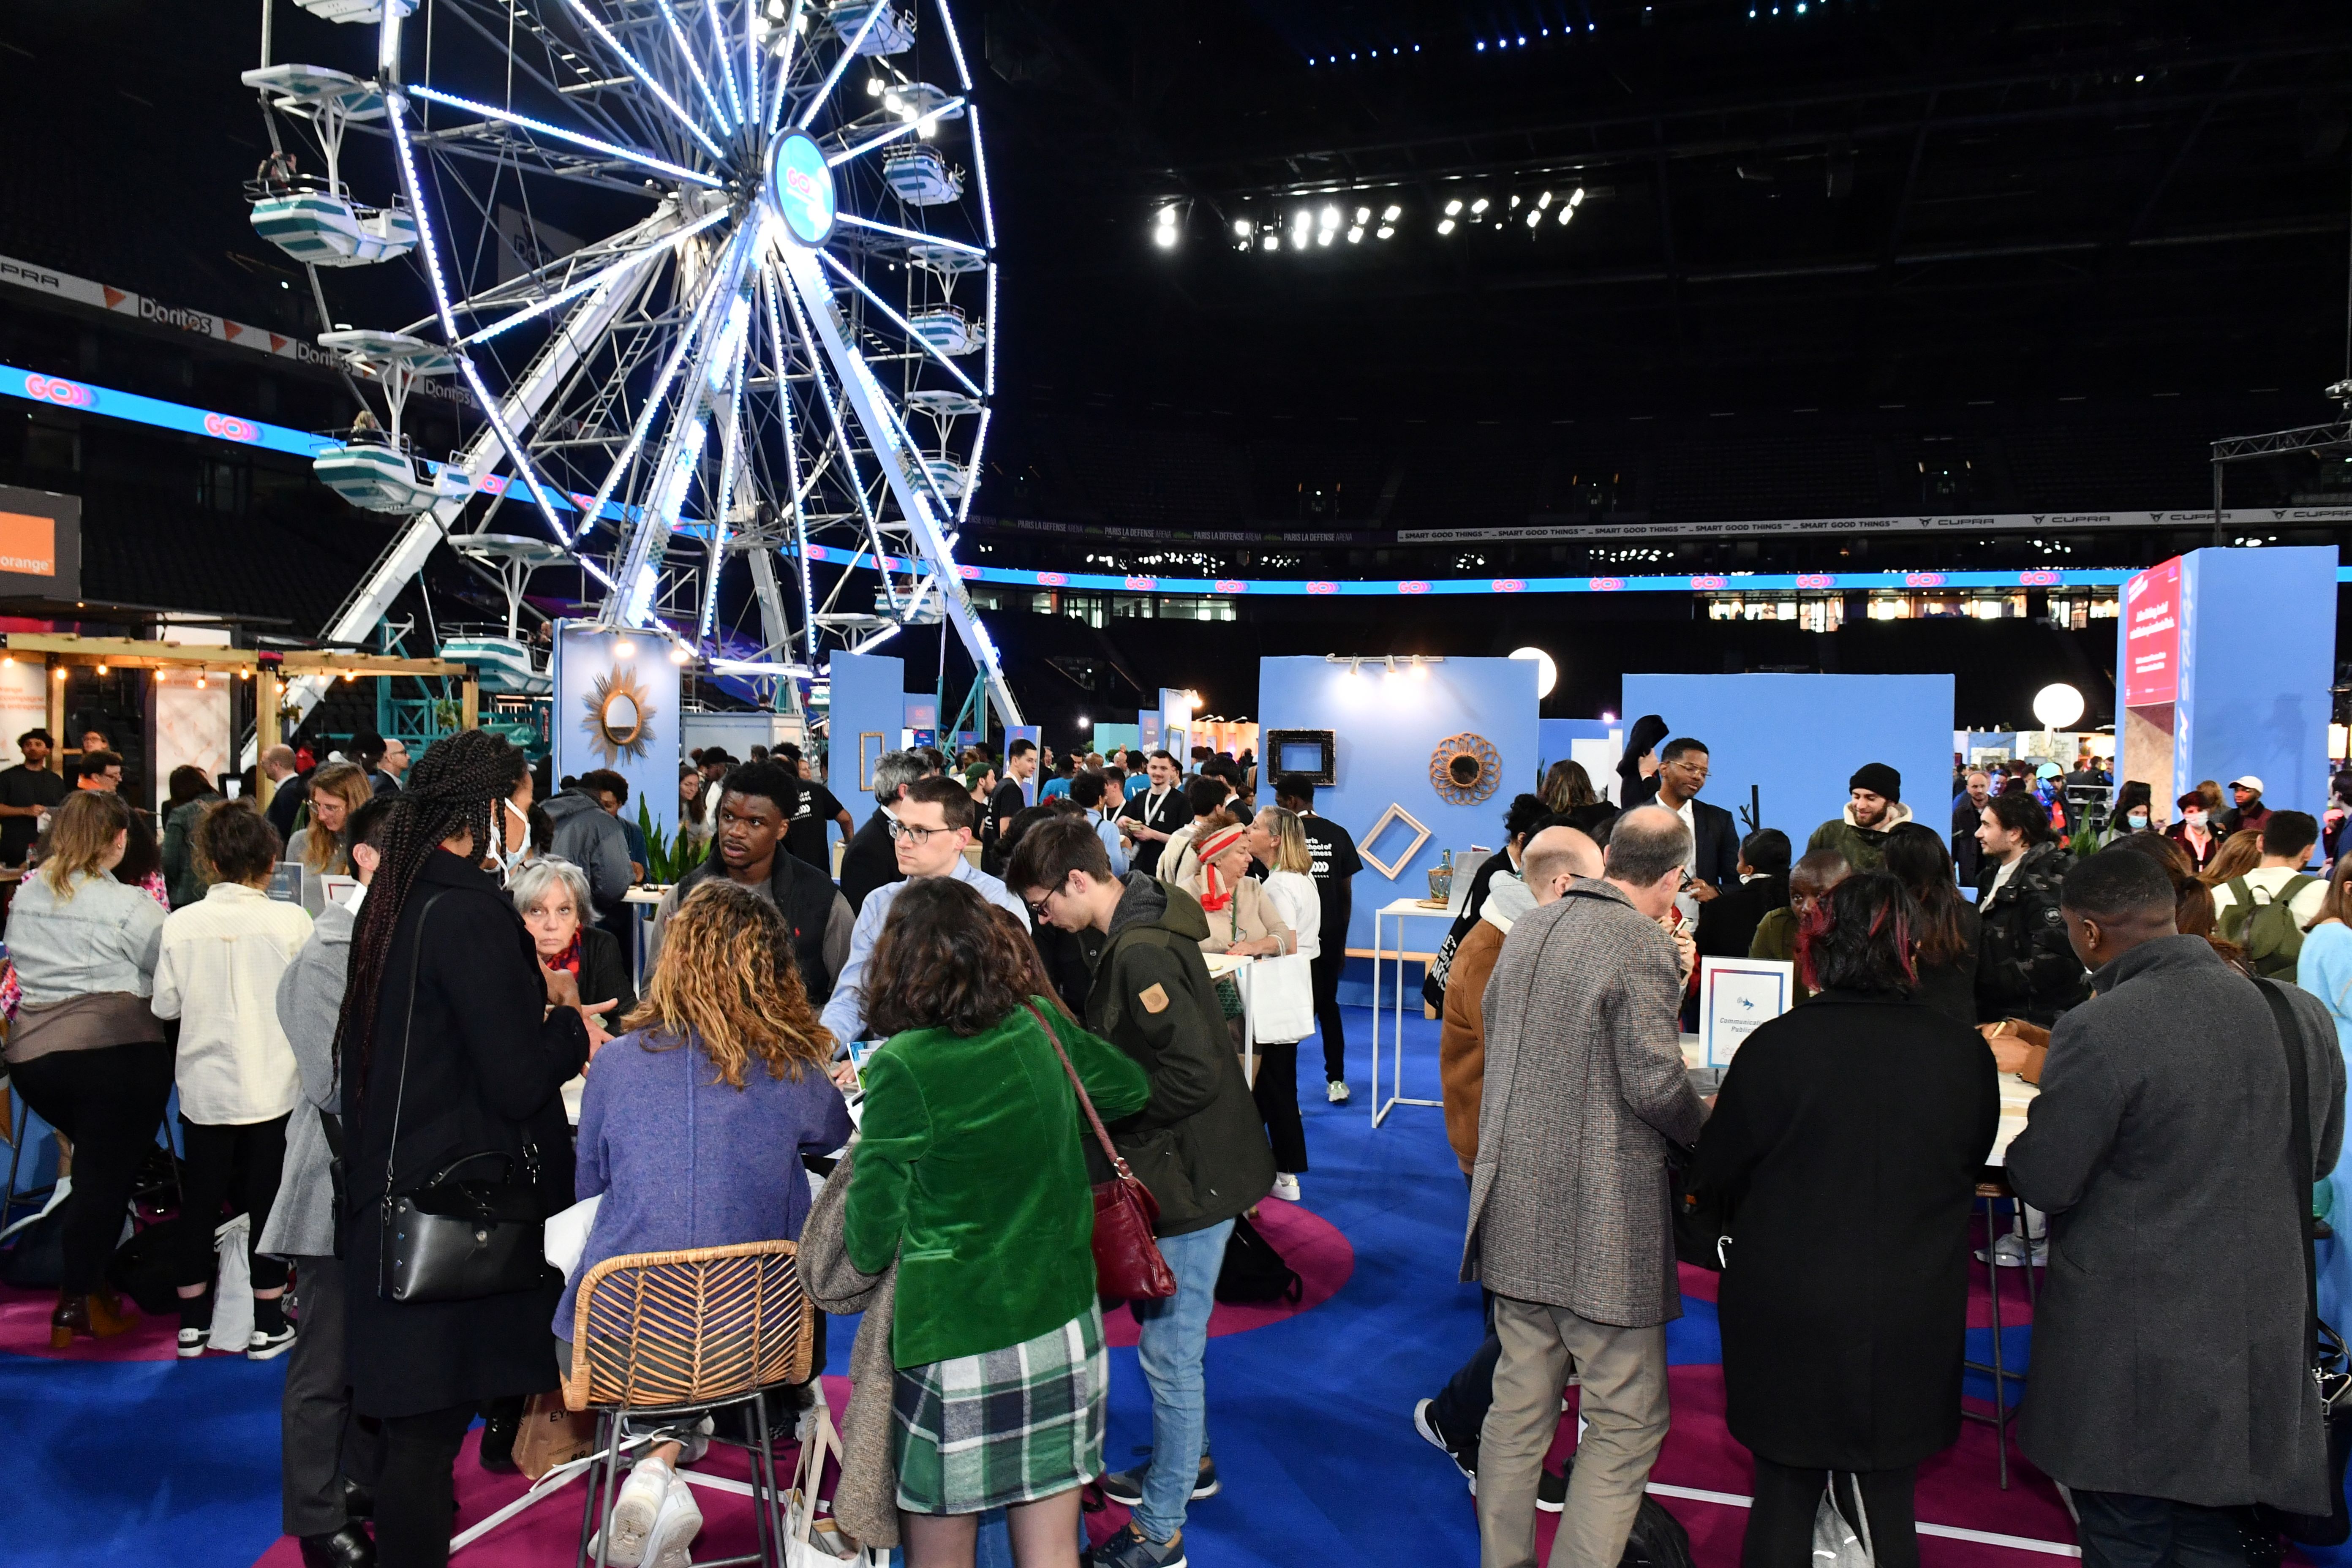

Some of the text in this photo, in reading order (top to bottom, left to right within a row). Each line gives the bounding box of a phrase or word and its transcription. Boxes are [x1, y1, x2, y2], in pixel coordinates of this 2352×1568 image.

[787, 168, 810, 194] GO
[140, 297, 211, 334] Doritos
[297, 342, 353, 373] Doris
[25, 374, 74, 405] GO
[204, 413, 245, 440] GO
[1018, 520, 1034, 529] PARIS
[1035, 521, 1042, 530] LA
[1042, 522, 1066, 532] DEFENSE
[1105, 527, 1121, 536] PARIS
[1122, 528, 1130, 536] LA
[1130, 528, 1154, 538] DEFENSE
[1194, 531, 1211, 539] PARIS
[1211, 531, 1218, 540] LA
[1219, 531, 1244, 541] DEFENSE
[1284, 533, 1301, 541] PARIS
[1301, 533, 1309, 541] LA
[1310, 533, 1335, 542] DEFENSE
[0, 555, 48, 573] orange
[1037, 571, 1059, 586] GO
[1125, 577, 1148, 591] GO
[1590, 577, 1614, 591] GO
[1691, 576, 1717, 589] GO
[1796, 574, 1823, 588] GO
[1906, 572, 1934, 587] GO
[2020, 571, 2050, 586] GO
[1215, 580, 1238, 593] GO
[1306, 581, 1330, 595] GO
[1398, 580, 1422, 595] GO
[1492, 579, 1516, 593] GO
[1720, 1017, 1765, 1026] Communicati
